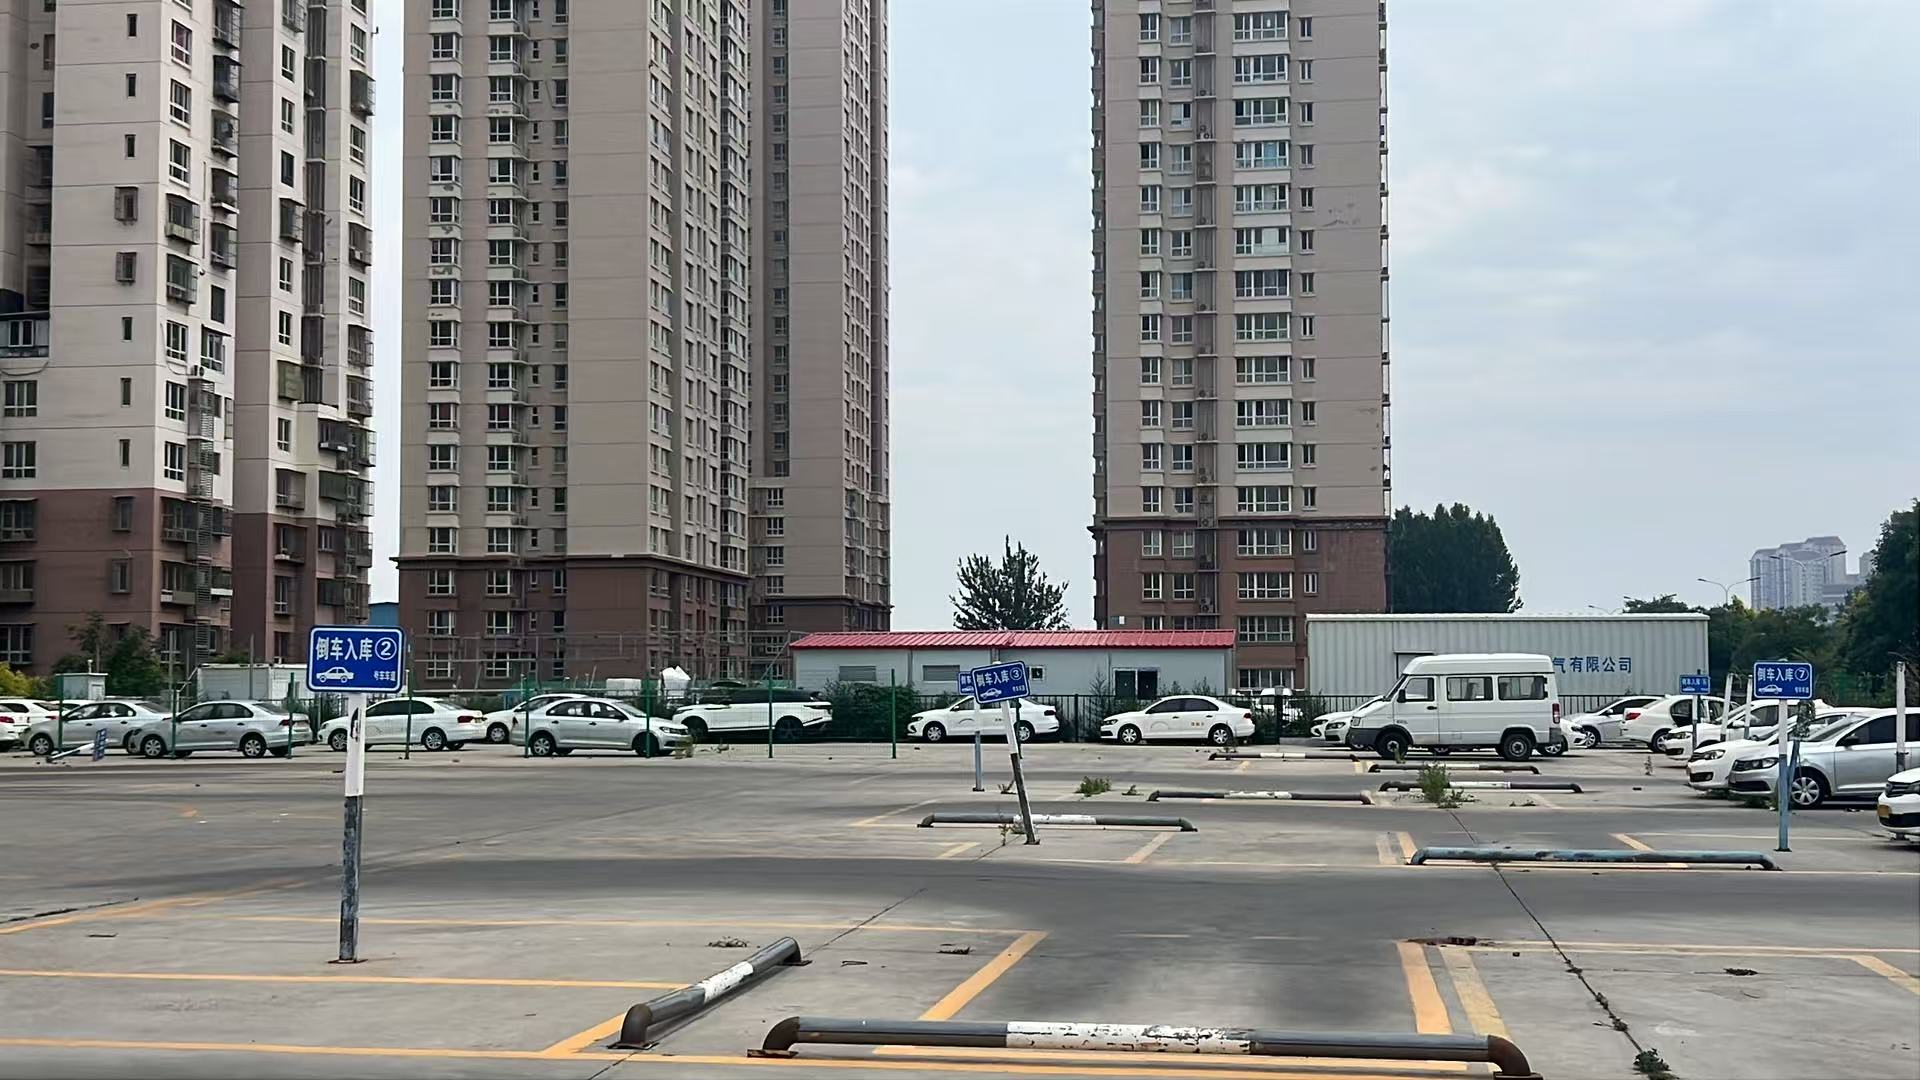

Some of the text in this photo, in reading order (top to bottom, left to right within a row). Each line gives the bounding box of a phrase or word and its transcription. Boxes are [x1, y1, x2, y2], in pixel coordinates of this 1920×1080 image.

[1552, 656, 1632, 674] 气有限公司
